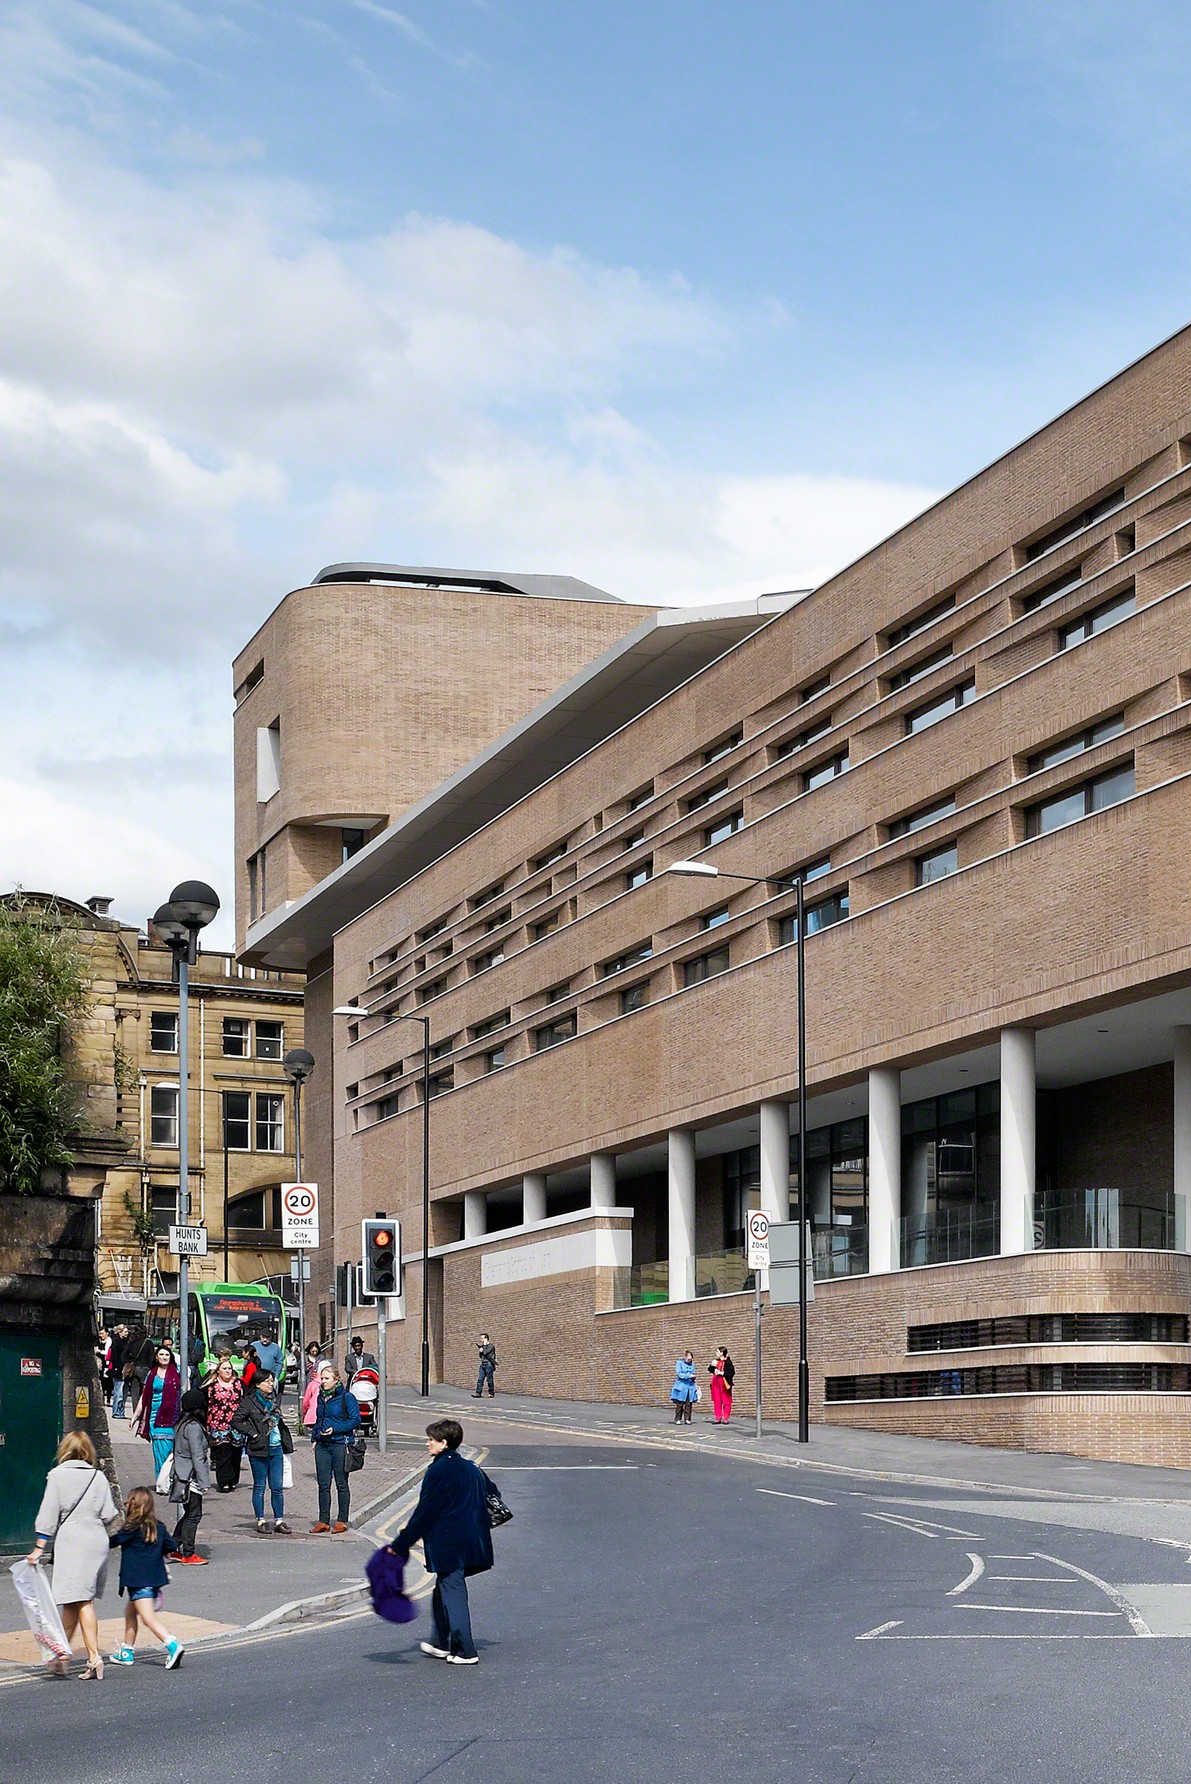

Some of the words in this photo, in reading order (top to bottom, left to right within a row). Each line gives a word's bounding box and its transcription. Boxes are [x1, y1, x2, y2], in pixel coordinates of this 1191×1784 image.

[290, 1195, 311, 1207] 20
[753, 1221, 767, 1232] 20
[175, 1228, 201, 1240] HUNTS
[178, 1241, 199, 1253] BANK
